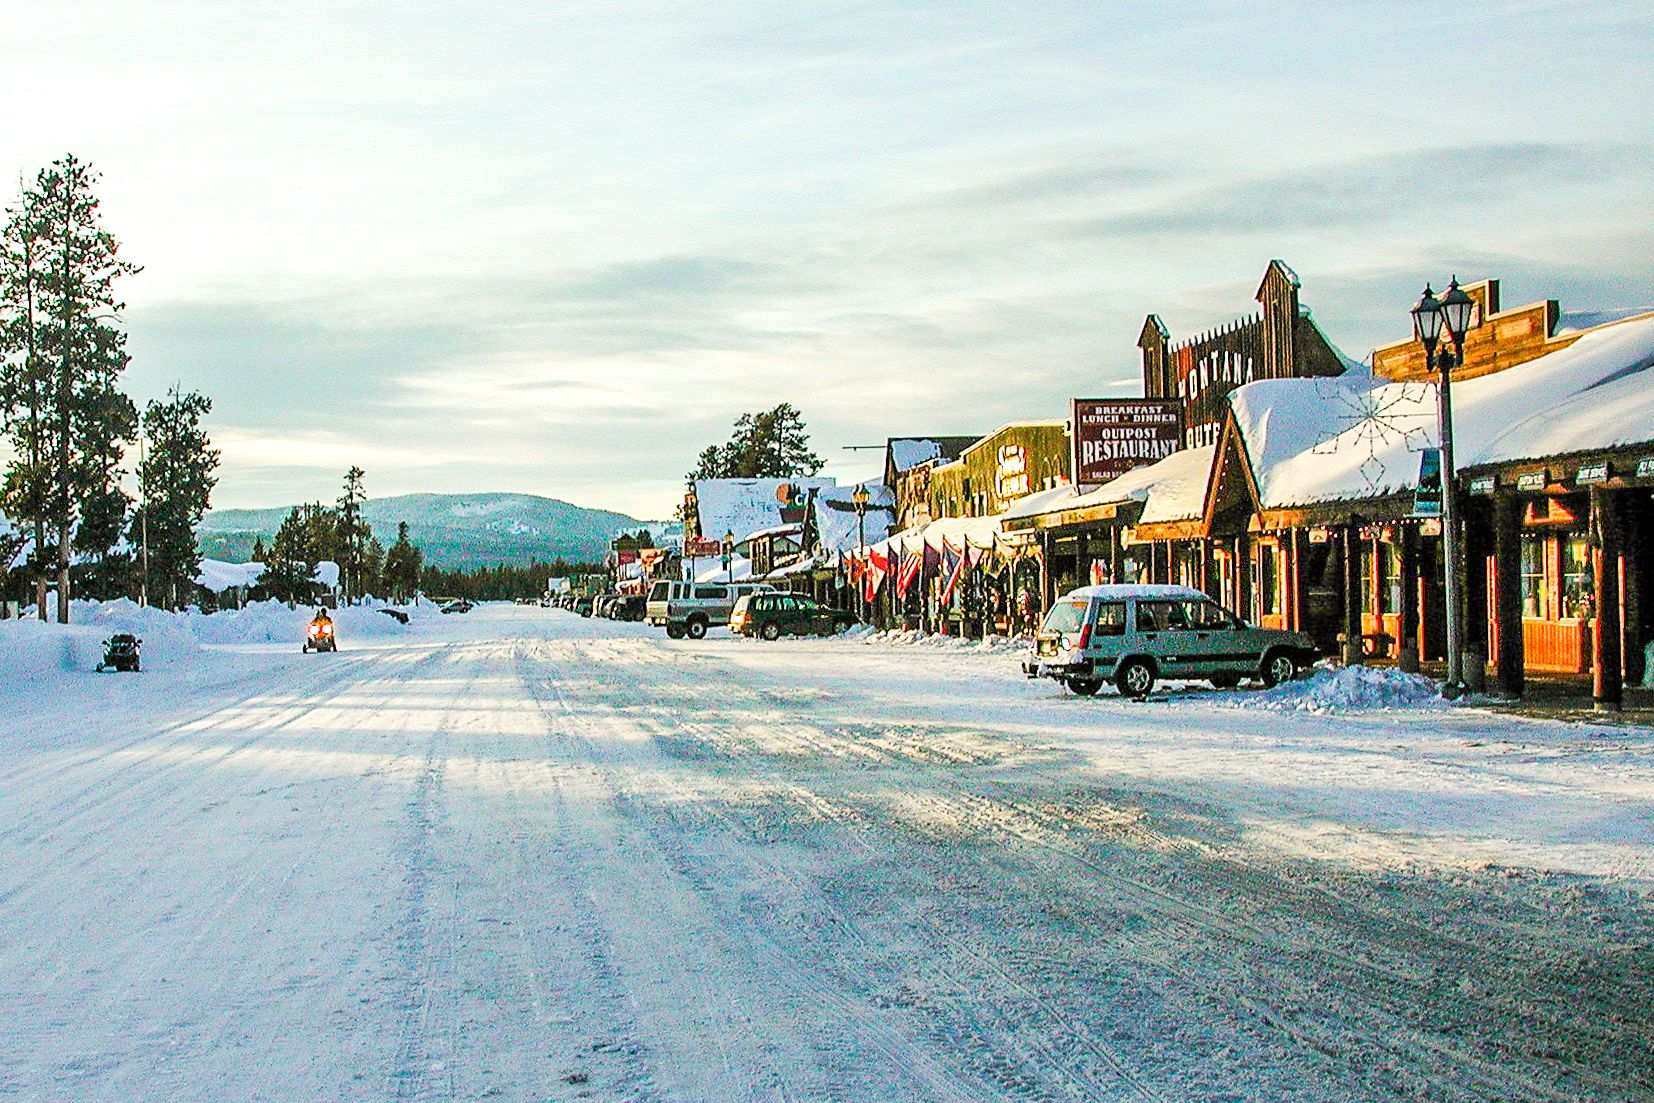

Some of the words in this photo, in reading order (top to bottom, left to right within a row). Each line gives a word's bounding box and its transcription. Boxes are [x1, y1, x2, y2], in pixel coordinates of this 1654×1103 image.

[1095, 406, 1163, 415] BREAKFAST
[1082, 414, 1119, 423] LUNCH
[1133, 414, 1176, 423] DINNER
[1102, 428, 1157, 439] OUTPOST
[1082, 440, 1178, 466] RESTAURANT
